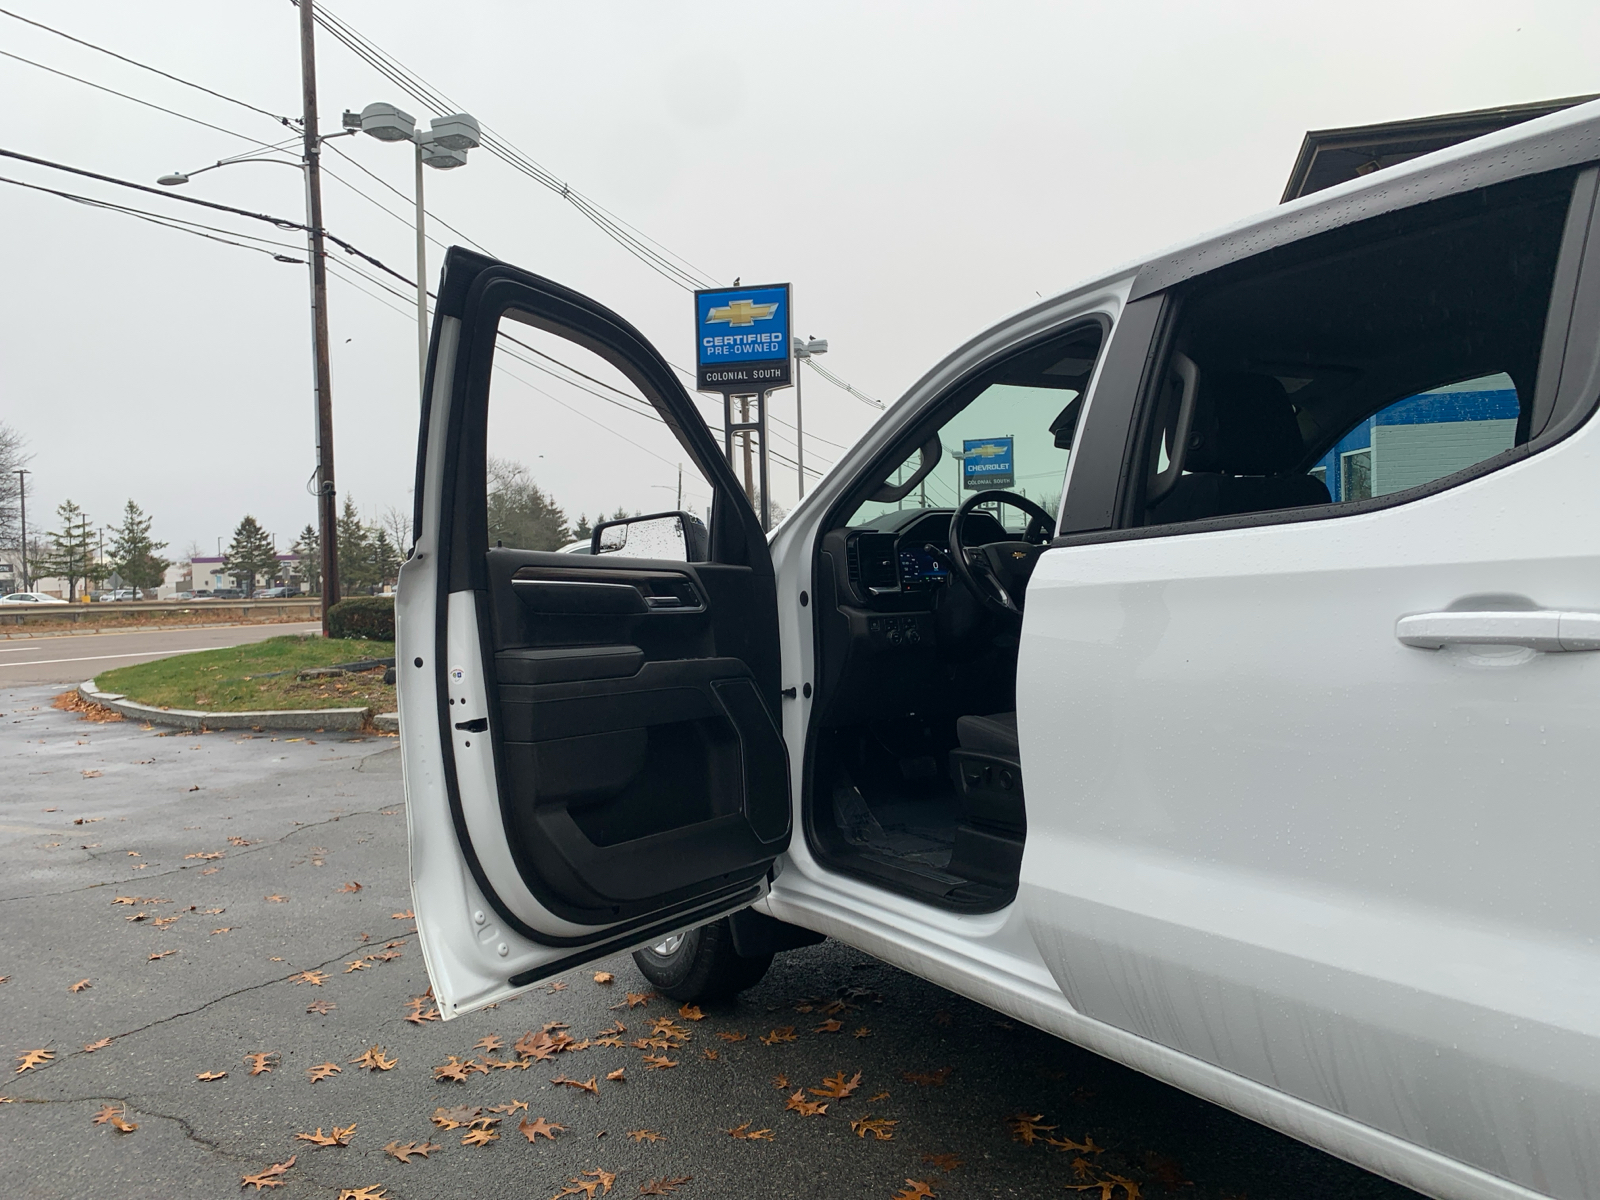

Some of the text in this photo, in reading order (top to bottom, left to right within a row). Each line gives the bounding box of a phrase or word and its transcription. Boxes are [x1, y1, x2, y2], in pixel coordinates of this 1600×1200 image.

[703, 332, 782, 346] CERTIFIED
[707, 343, 779, 355] PRE-OWNED
[706, 369, 781, 381] COLONIAL SOUTH
[967, 463, 1009, 471] CHEVROLET
